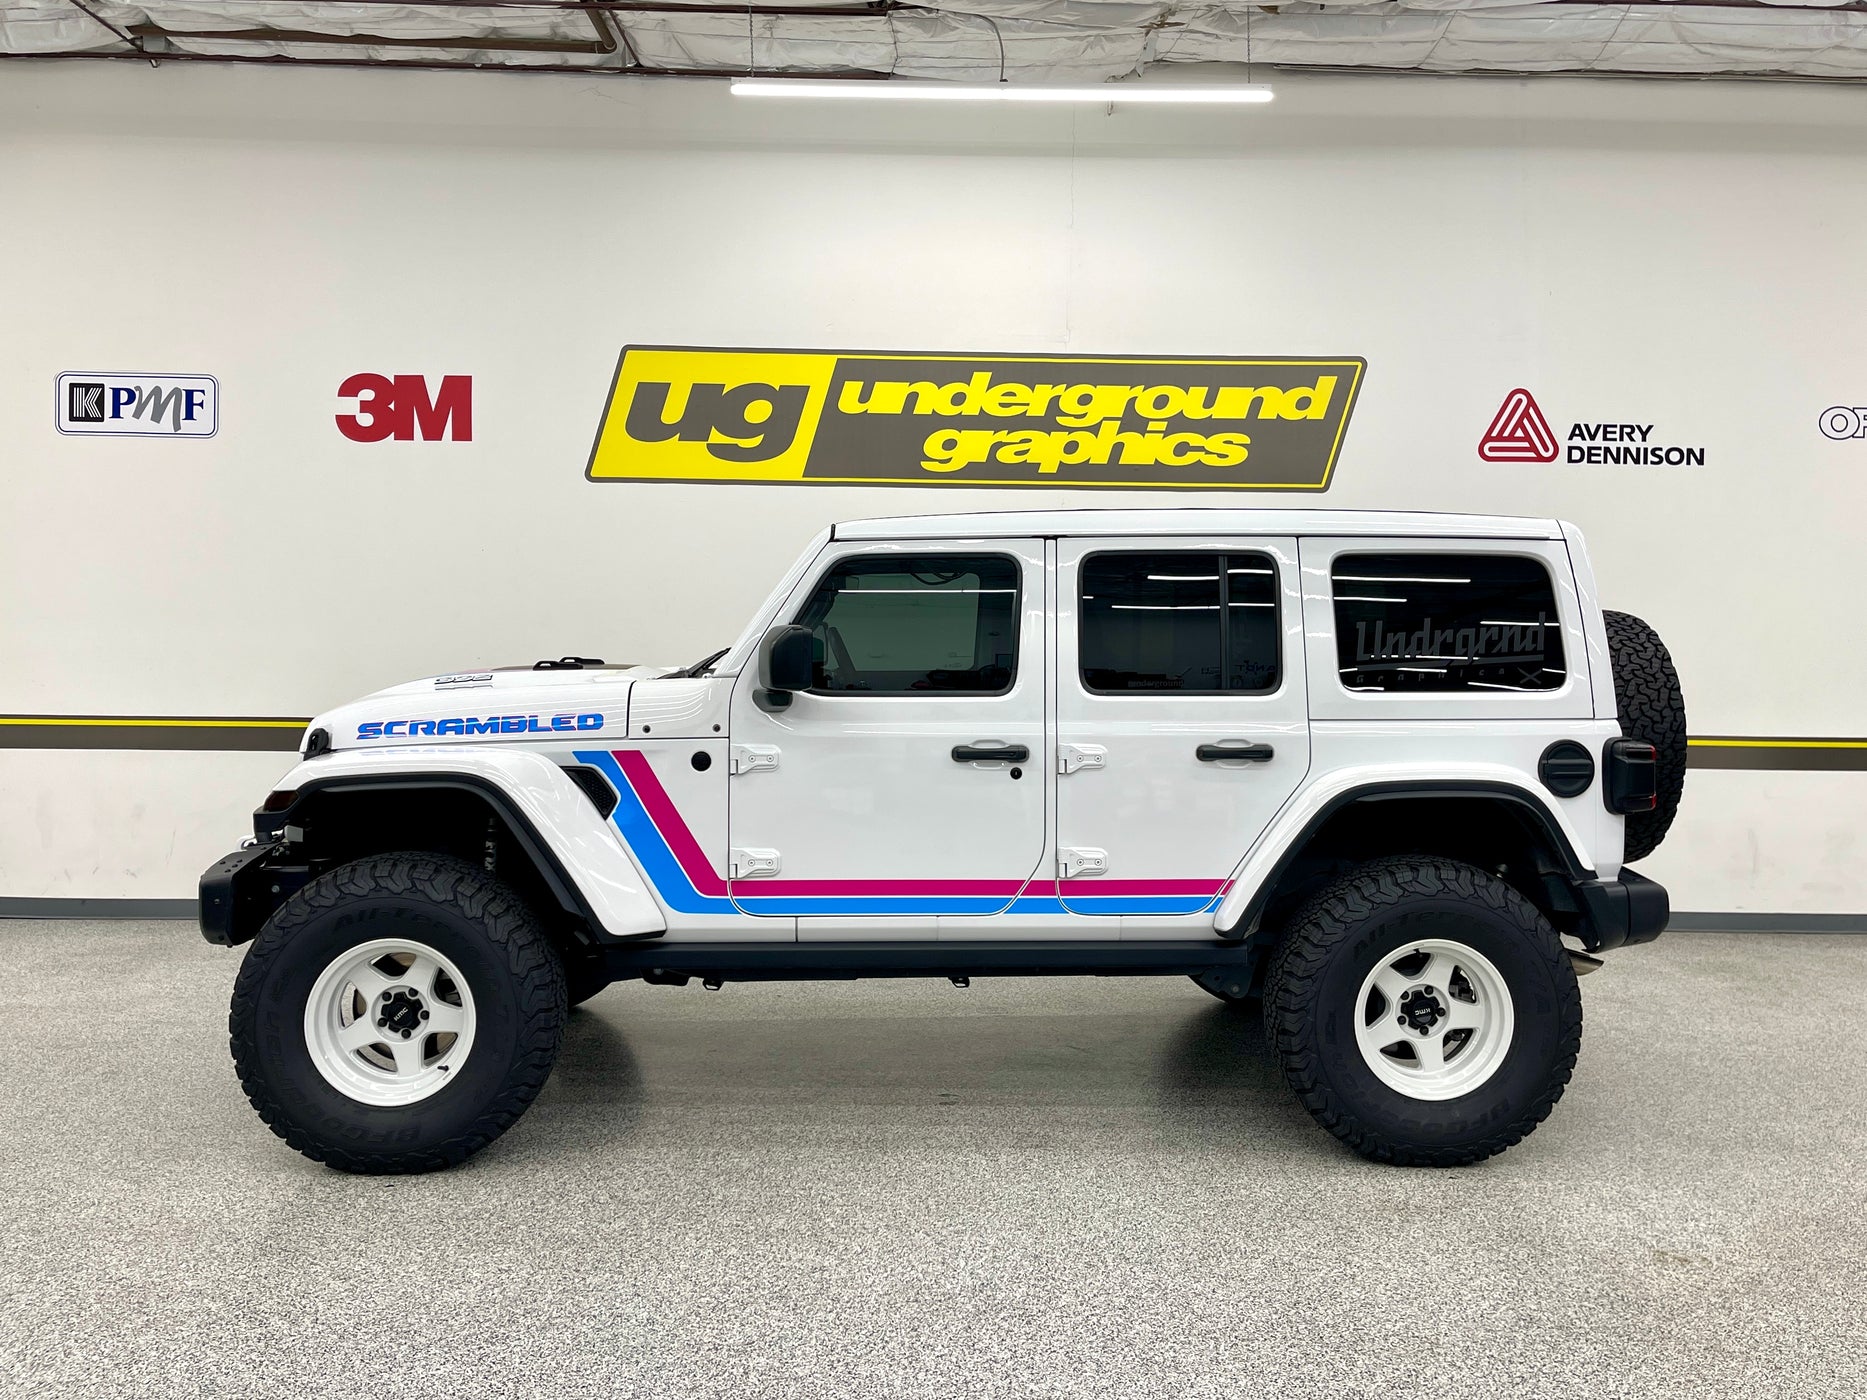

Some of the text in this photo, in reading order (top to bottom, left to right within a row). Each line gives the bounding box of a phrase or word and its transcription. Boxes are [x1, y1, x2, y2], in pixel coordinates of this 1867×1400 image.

[335, 372, 473, 442] 3M
[624, 381, 811, 464] ug
[838, 371, 1337, 428] underground
[920, 420, 1251, 474] graphics
[1566, 445, 1705, 466] DENNISON
[1567, 423, 1654, 442] AVERY
[1355, 611, 1546, 666] Undrgrnd
[356, 713, 604, 740] SCRAMBLED
